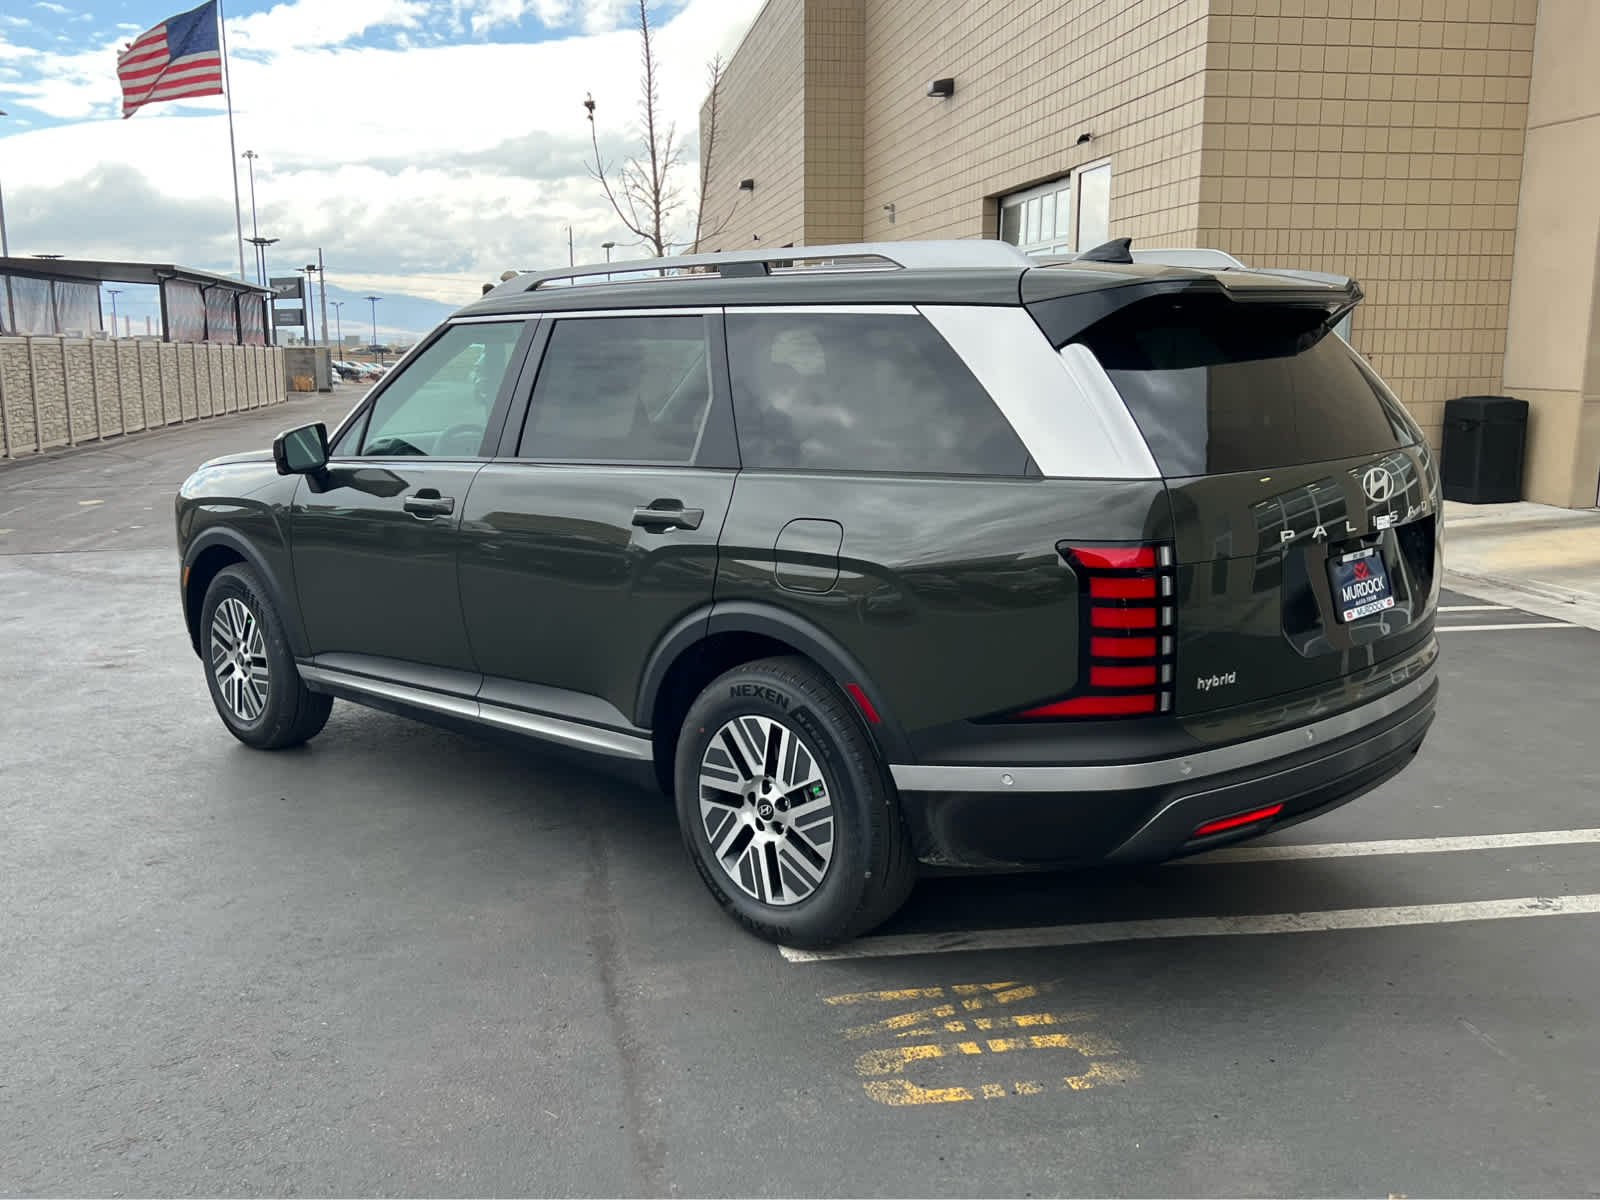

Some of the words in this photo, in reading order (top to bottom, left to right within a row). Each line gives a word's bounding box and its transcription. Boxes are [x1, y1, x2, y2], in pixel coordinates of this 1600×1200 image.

[1342, 576, 1385, 602] MURDOCK
[1357, 602, 1385, 616] MURDOCK
[1197, 671, 1236, 691] hybrid
[730, 684, 790, 709] NEXEN
